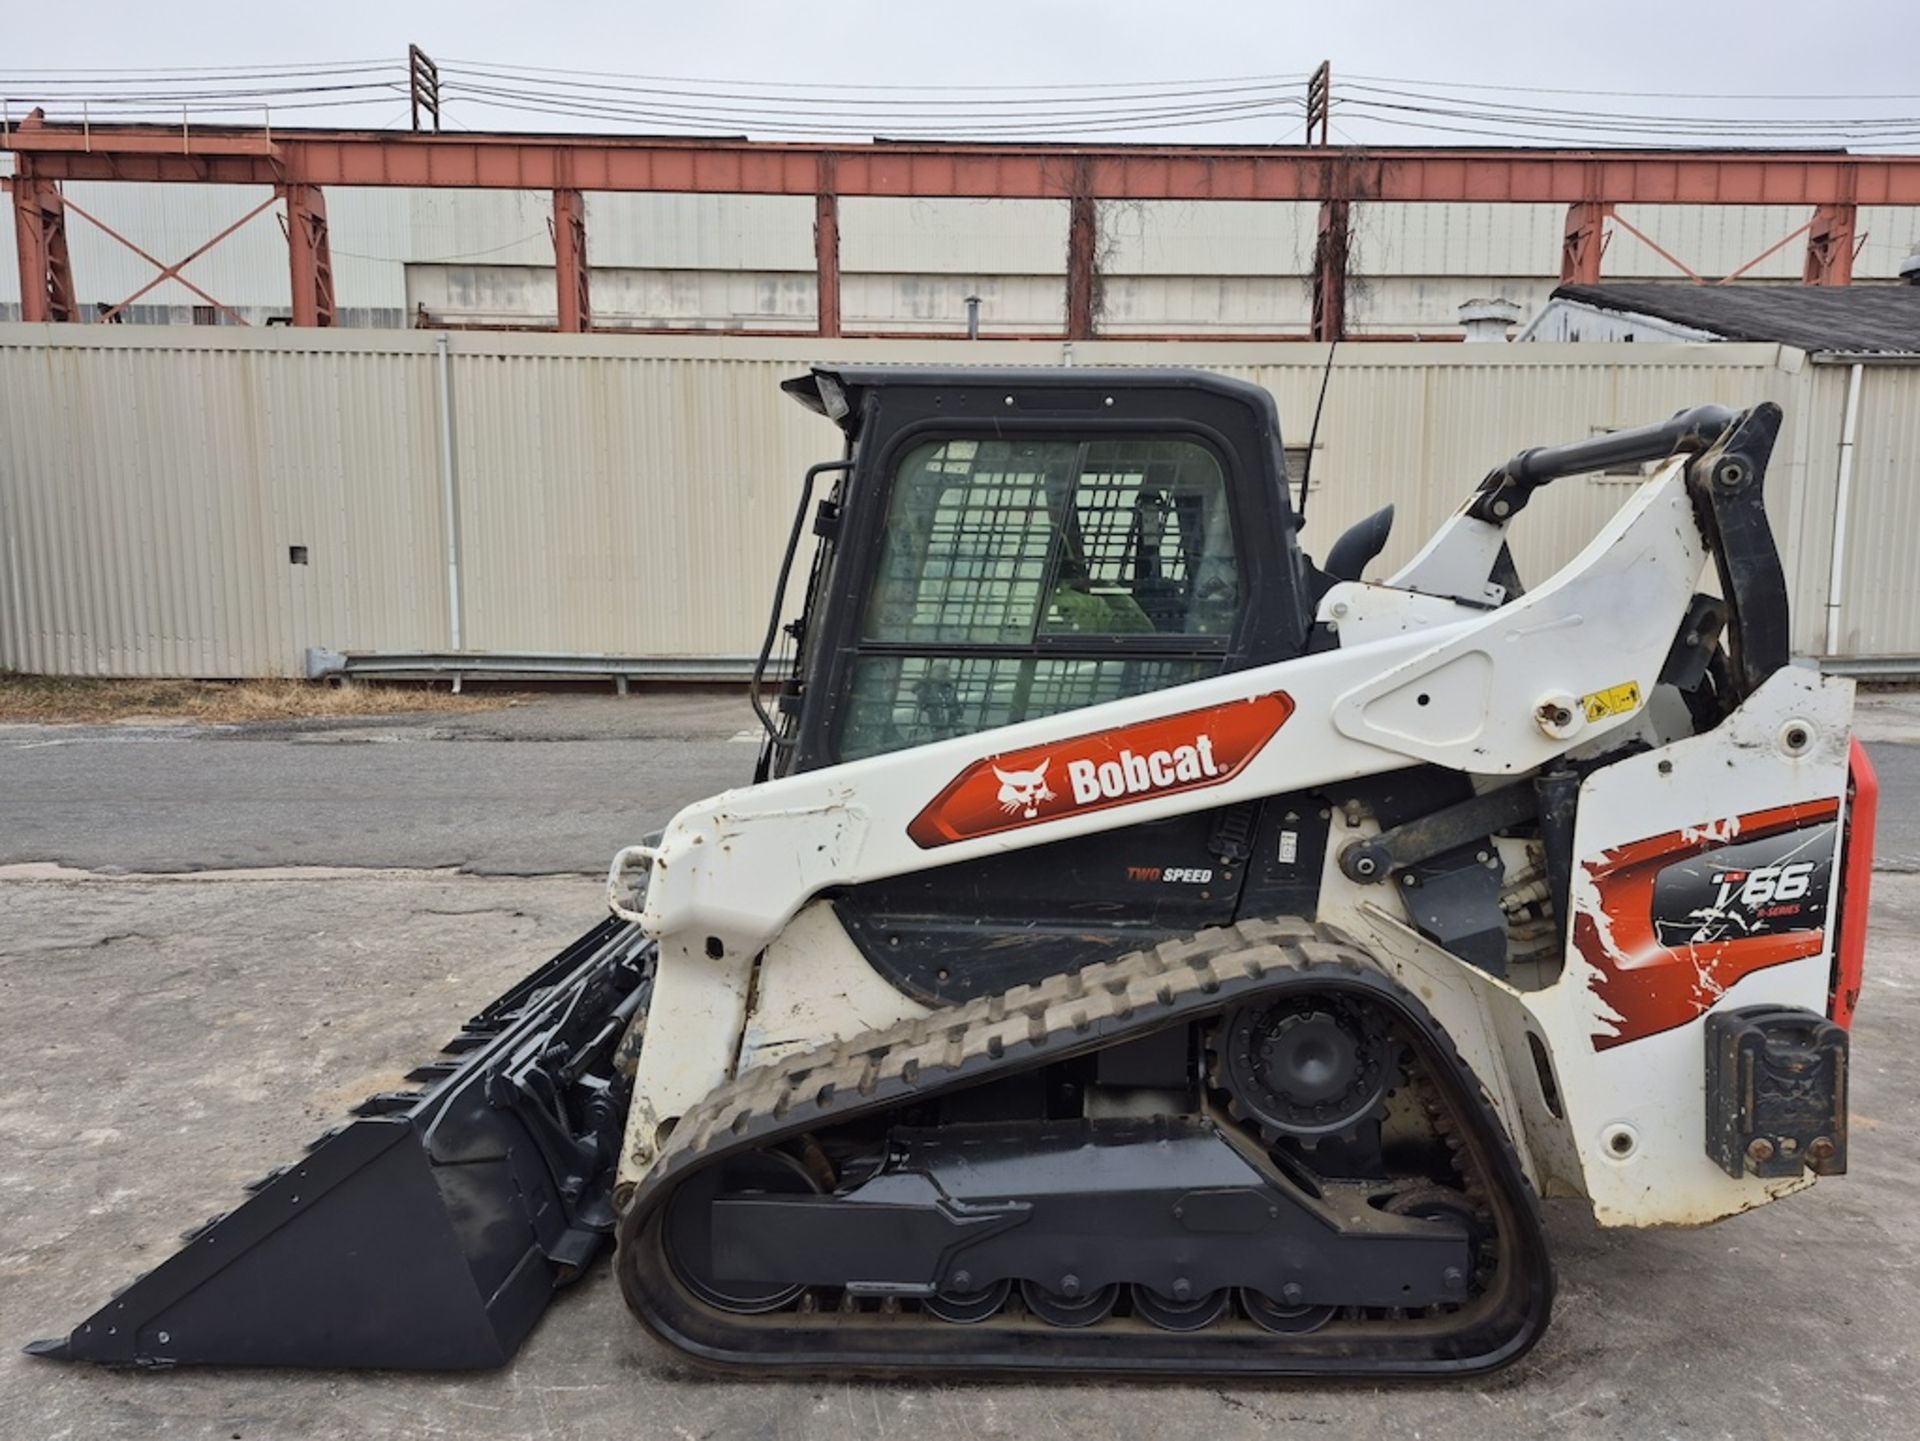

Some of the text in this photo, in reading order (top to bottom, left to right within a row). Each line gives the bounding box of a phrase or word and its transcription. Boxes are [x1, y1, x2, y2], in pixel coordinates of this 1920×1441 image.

[1068, 735, 1218, 804] Bobcat
[1127, 867, 1212, 883] TWO SPEED
[1712, 863, 1814, 910] T66
